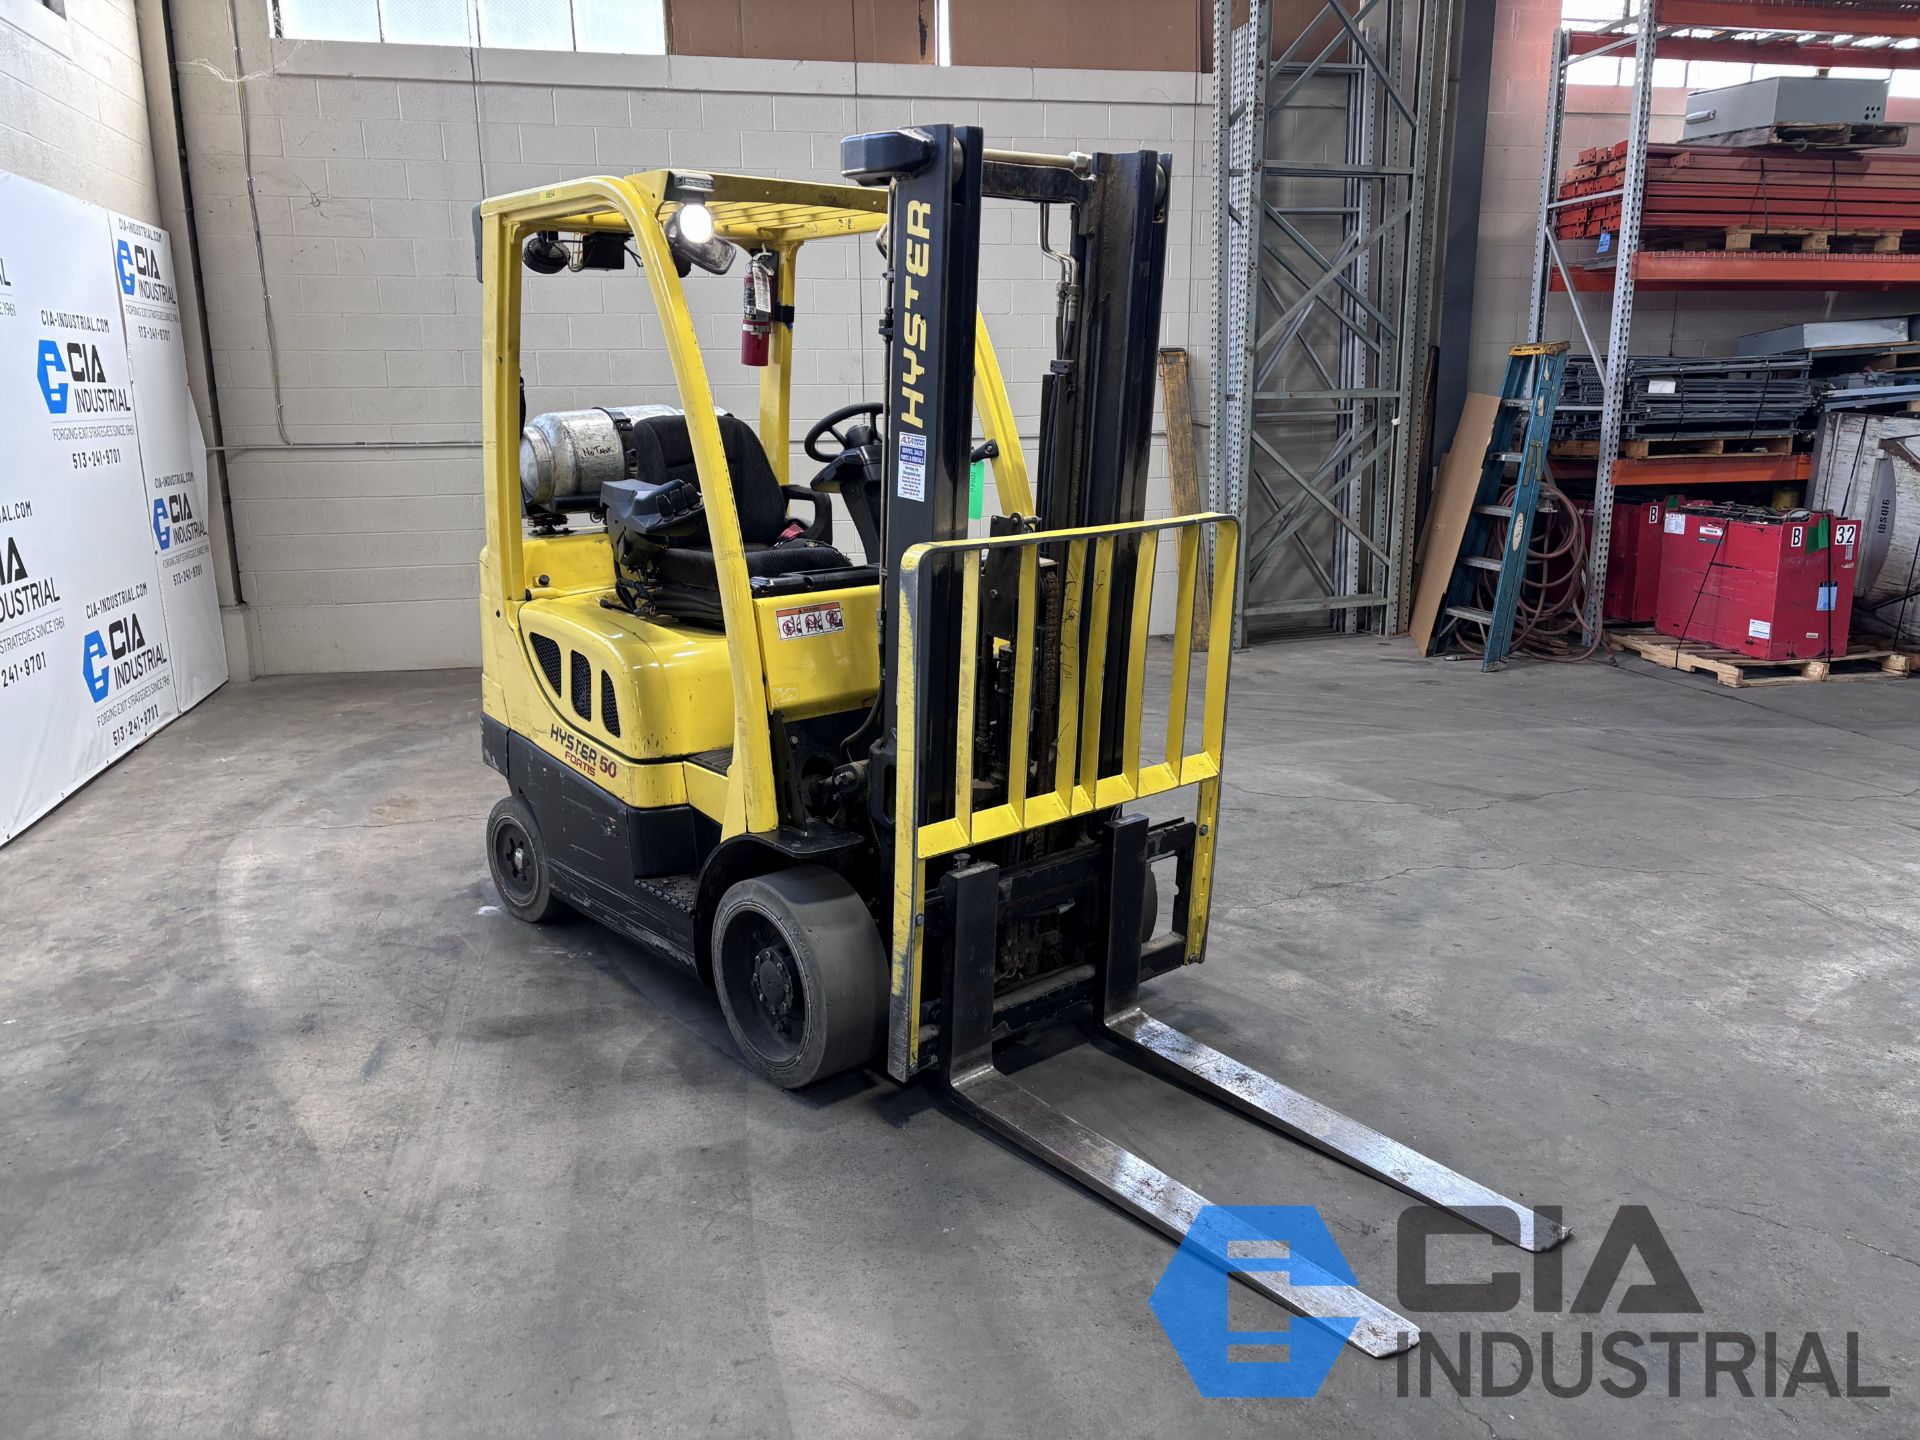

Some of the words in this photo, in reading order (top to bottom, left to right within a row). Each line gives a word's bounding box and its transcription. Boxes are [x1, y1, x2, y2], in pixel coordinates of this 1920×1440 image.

[134, 245, 161, 280] CIA
[138, 280, 177, 304] INDUSTRIAL
[41, 310, 110, 333] CIA-INDUSTRIAL.COM
[901, 200, 931, 429] HYSTER
[67, 342, 107, 383] CIA
[74, 388, 131, 413] INDUSTRIAL
[582, 447, 594, 457] No
[168, 492, 193, 523] CIA
[1651, 507, 1657, 522] B
[173, 519, 208, 545] INDUSTRIAL
[1792, 528, 1801, 546] B
[1836, 526, 1855, 544] 32
[86, 582, 148, 619] CIA-INDUSTRIAL.COM
[108, 612, 146, 661] CIA
[114, 643, 168, 690] INDUSTRIAL
[550, 723, 597, 767] HYSTER
[600, 755, 617, 779] 50
[565, 750, 596, 777] FORTIS
